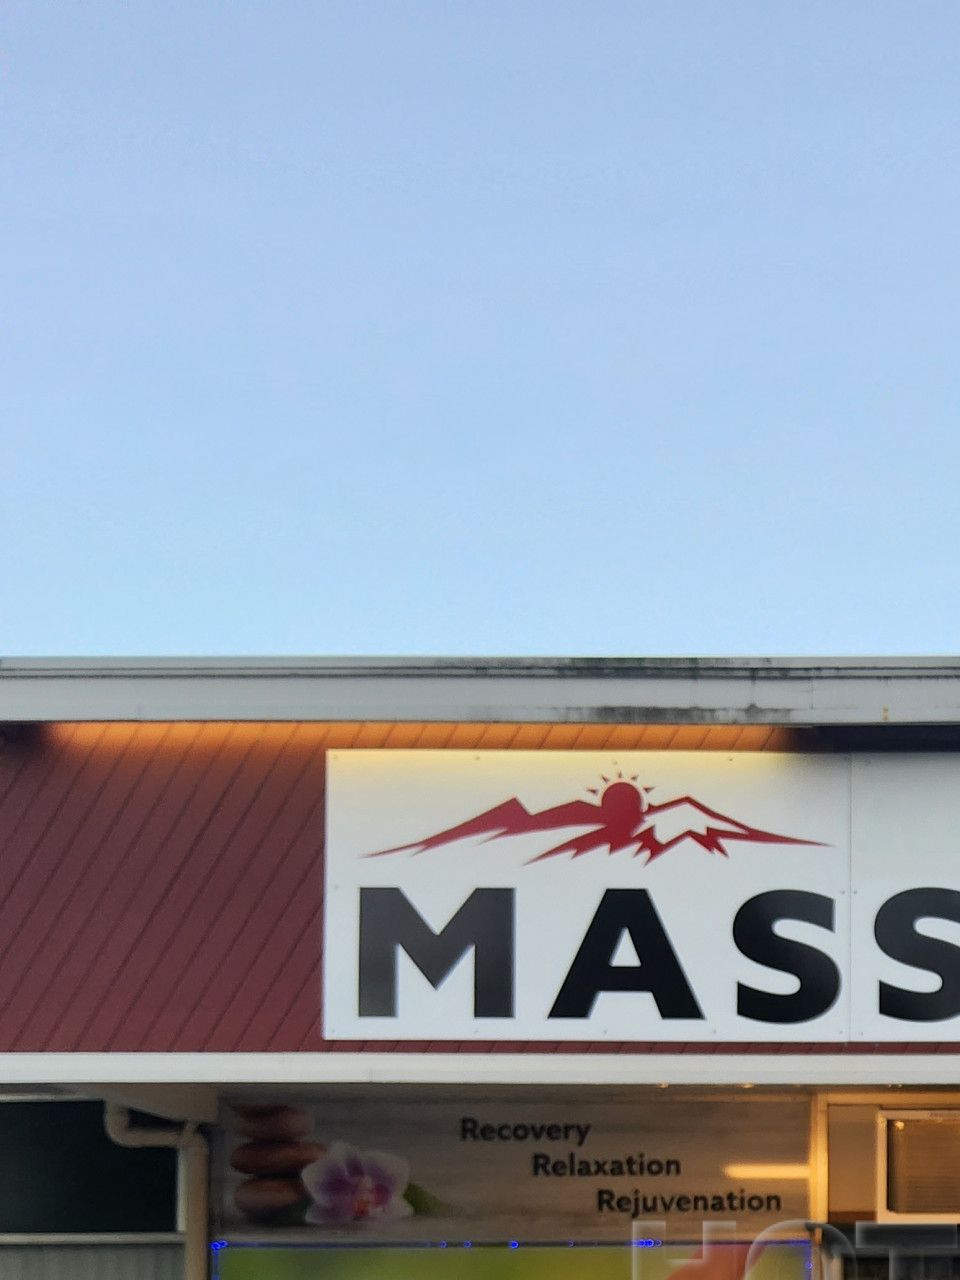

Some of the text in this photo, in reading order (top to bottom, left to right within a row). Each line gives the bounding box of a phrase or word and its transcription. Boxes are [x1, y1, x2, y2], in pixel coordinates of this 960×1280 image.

[461, 1117, 591, 1146] Recovery
[533, 1152, 682, 1177] Relaxation
[597, 1187, 783, 1217] Rejuvenation
